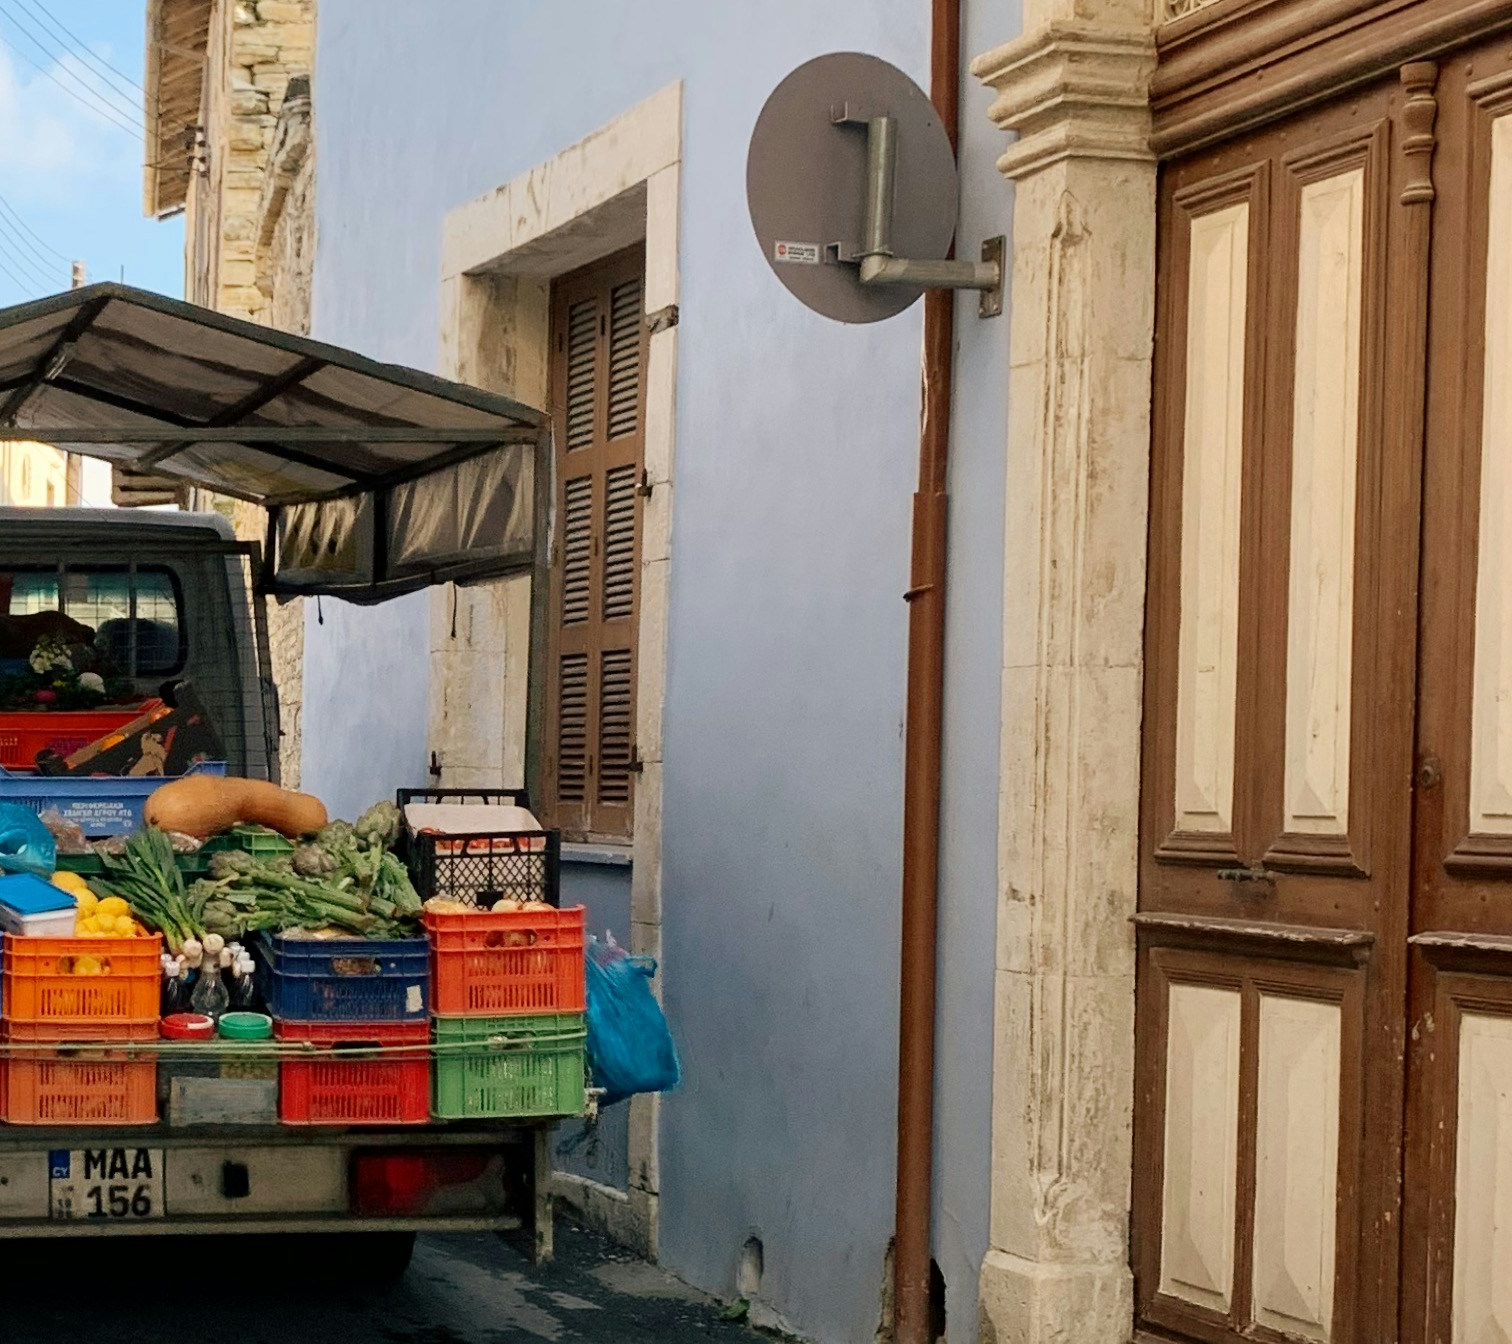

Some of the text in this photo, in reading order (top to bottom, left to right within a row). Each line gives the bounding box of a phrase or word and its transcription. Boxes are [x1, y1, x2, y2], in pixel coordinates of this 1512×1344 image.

[52, 1166, 68, 1177] CY
[84, 1147, 152, 1179] MAA
[87, 1185, 151, 1217] 156
